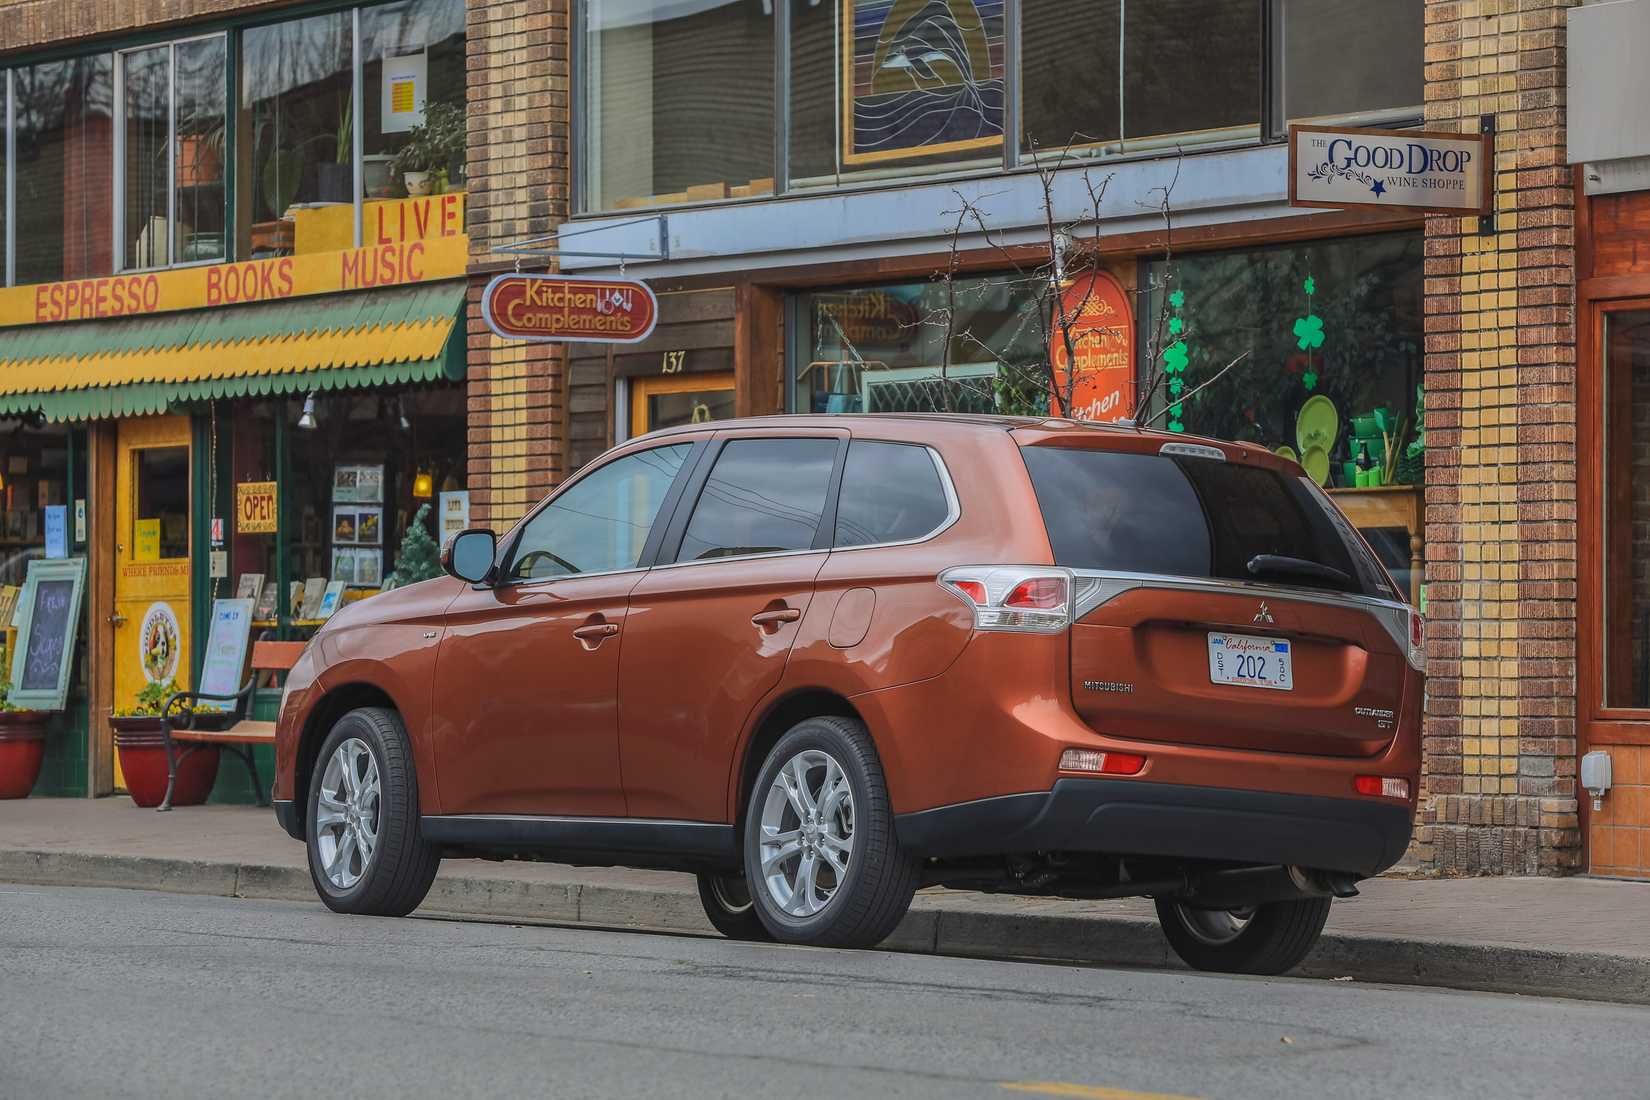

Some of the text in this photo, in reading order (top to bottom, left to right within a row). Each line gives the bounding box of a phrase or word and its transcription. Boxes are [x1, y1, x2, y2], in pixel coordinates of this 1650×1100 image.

[1311, 138, 1328, 148] THE
[1387, 176, 1466, 191] WINE SHOPPE
[378, 195, 457, 245] LIVE
[35, 242, 424, 323] ESPRESSO BOOKS MUSIC
[525, 278, 596, 308] Kitchen
[507, 299, 632, 334] Complements
[662, 350, 687, 374] 137
[1226, 637, 1271, 654] California
[1236, 654, 1267, 680] 202
[1084, 680, 1134, 693] MITSUBISHI
